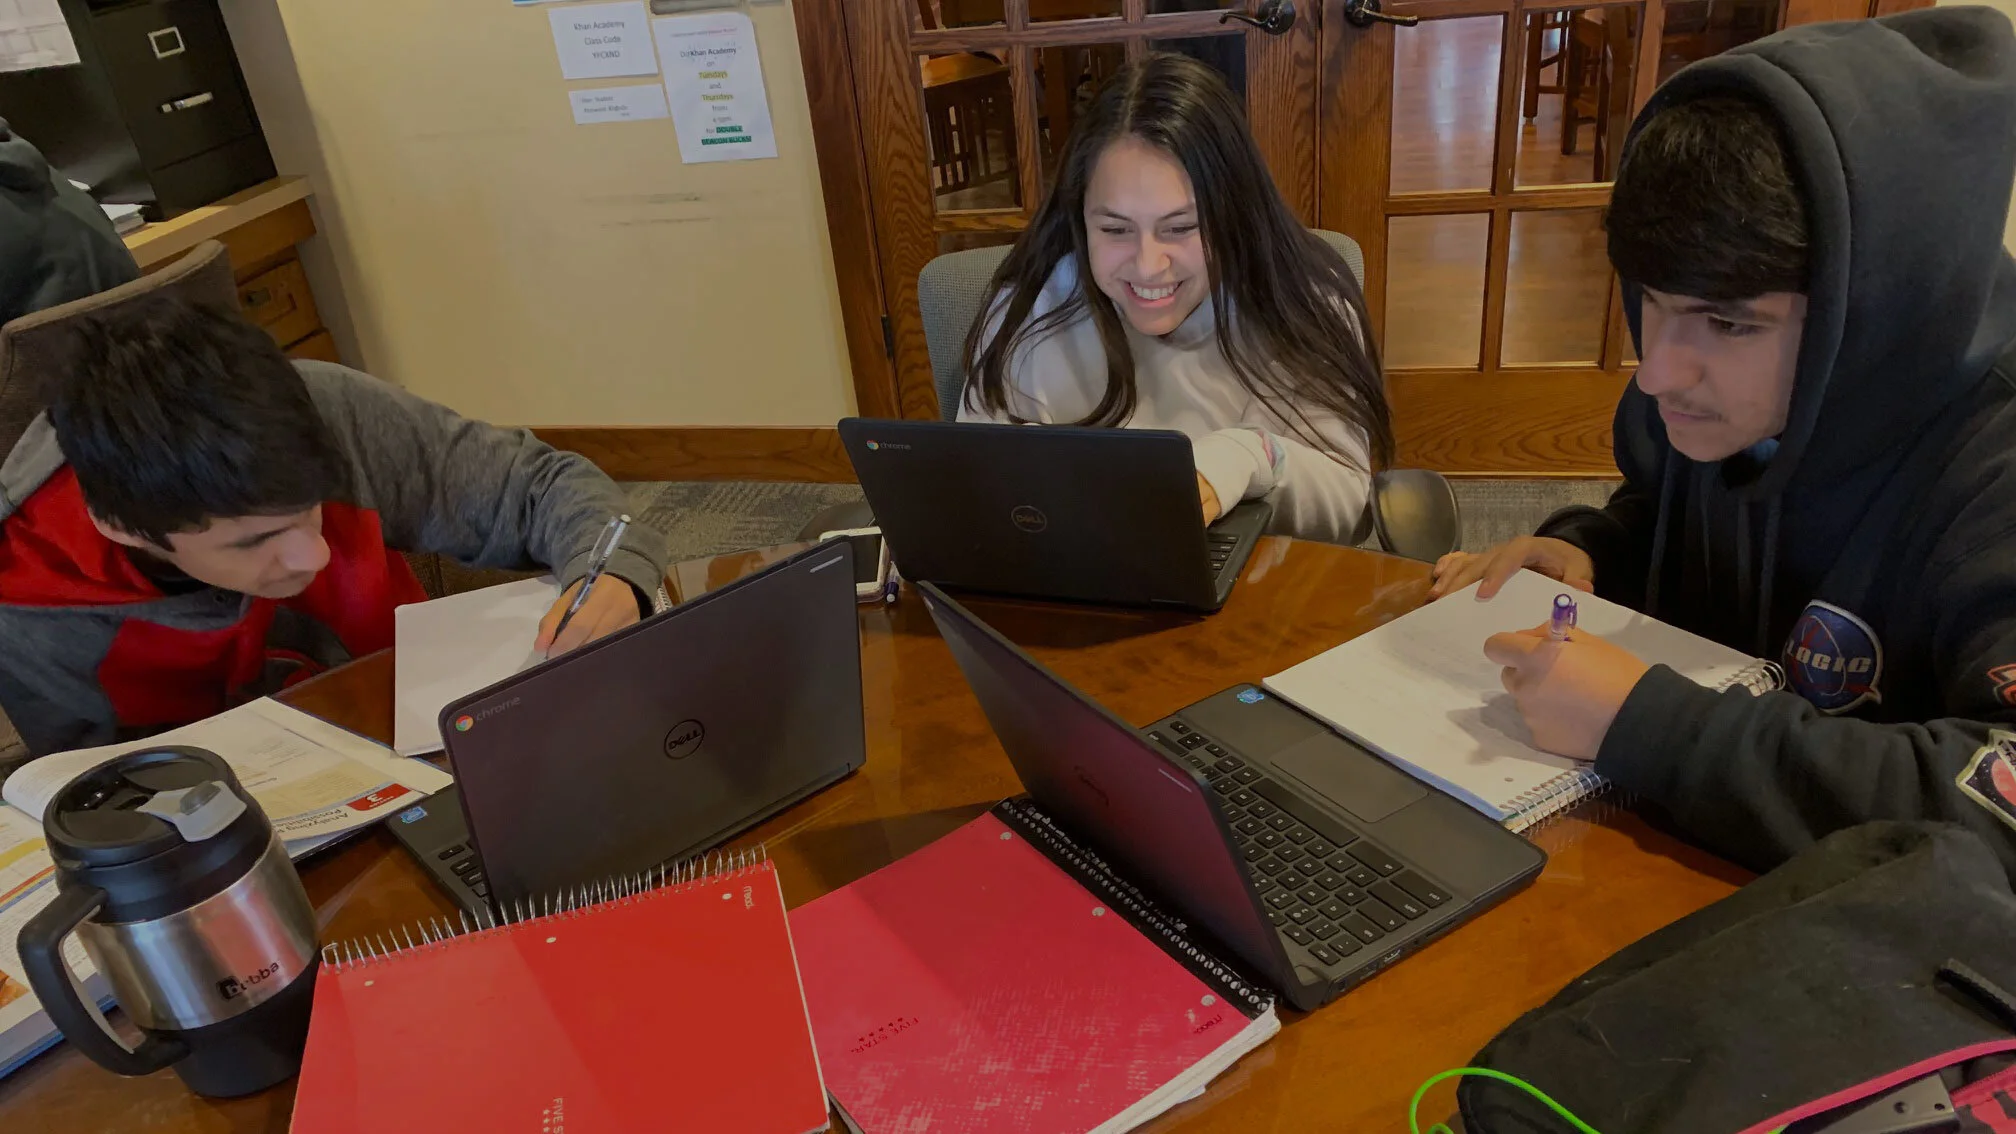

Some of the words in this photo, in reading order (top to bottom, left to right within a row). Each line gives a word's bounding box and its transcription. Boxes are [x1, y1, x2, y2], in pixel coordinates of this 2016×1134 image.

[573, 22, 592, 31] Khan
[593, 21, 625, 30] Academy
[584, 36, 603, 46] Class
[604, 35, 622, 45] Code
[690, 49, 707, 57] Khan
[708, 47, 737, 56] Academy
[699, 71, 728, 80] Tuesdays
[701, 93, 734, 102] Thursdays
[716, 125, 743, 134] DOUBLE
[879, 441, 911, 451] chrome
[1015, 514, 1044, 525] DELL
[1786, 641, 1872, 673] LOGIC
[476, 696, 521, 721] chrome
[668, 729, 701, 751] DELL
[285, 813, 349, 831] Analyzing
[889, 1017, 919, 1034] FIVE
[552, 1096, 564, 1124] FIVE
